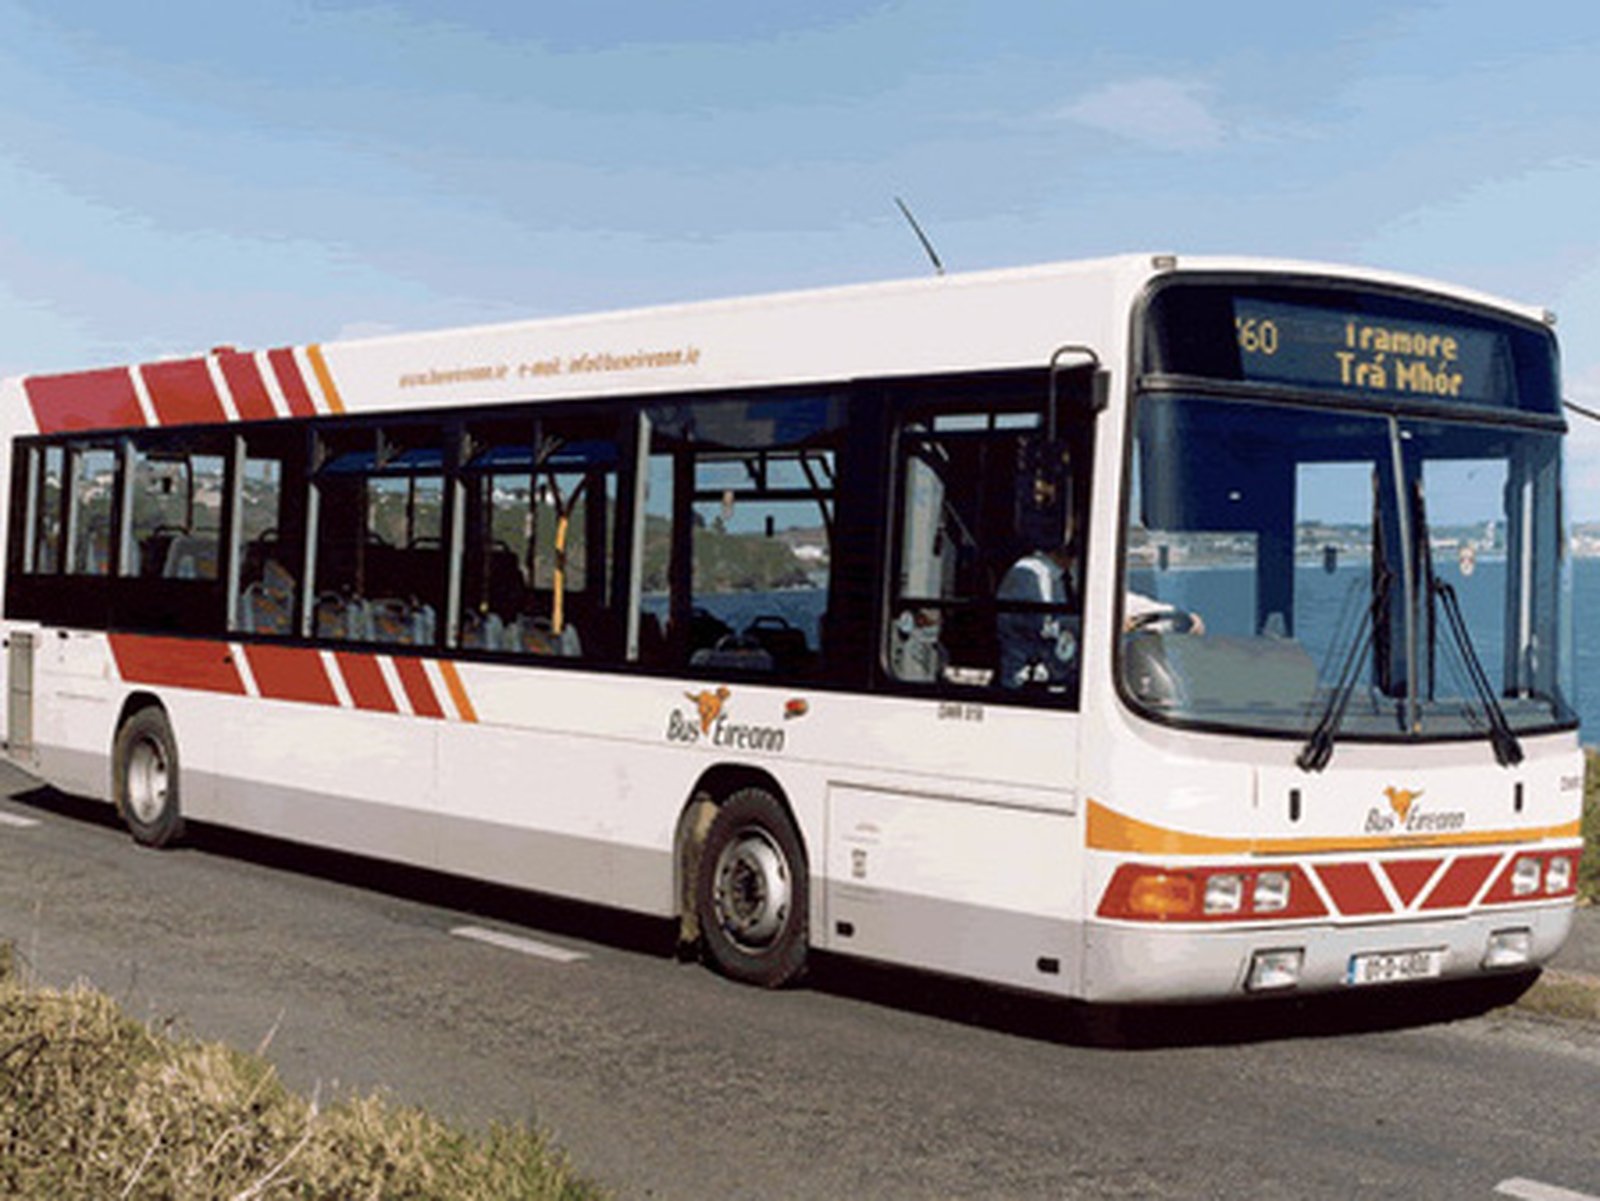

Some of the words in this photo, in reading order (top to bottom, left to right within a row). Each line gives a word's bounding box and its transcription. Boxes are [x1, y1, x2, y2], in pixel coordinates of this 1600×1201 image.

[1234, 317, 1278, 355] 60
[1335, 352, 1387, 389] Trá
[1396, 359, 1464, 397] Mhór
[667, 708, 699, 742] Bus
[1364, 807, 1395, 832] Bus
